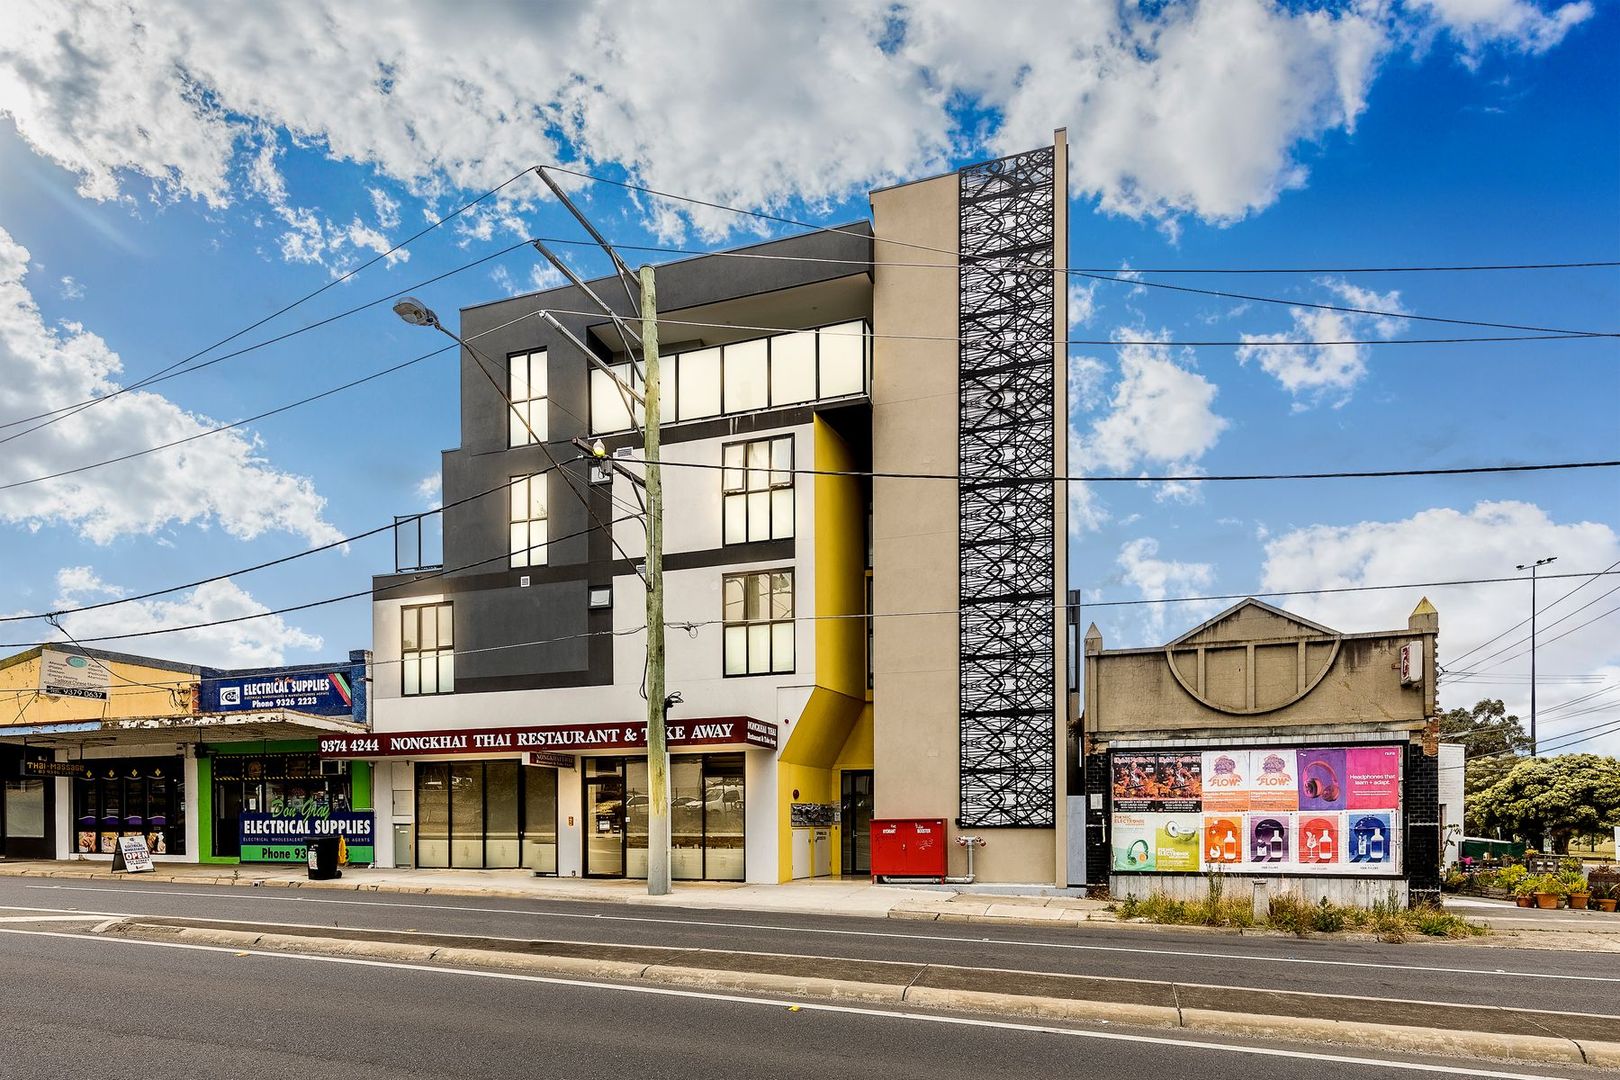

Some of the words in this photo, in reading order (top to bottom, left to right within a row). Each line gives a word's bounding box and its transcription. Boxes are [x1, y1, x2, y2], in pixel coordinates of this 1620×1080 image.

[244, 681, 289, 696] ELECTRICAL
[292, 678, 330, 692] SUPPLIES
[252, 700, 274, 708] Phone
[298, 697, 317, 705] 2223
[390, 736, 467, 750] NONGKHAI
[473, 734, 512, 747] THAI
[517, 729, 620, 746] RESTAURANT
[624, 728, 637, 742] &
[641, 726, 685, 741] TKE
[691, 724, 734, 739] AWAY
[321, 740, 347, 752] 9374
[350, 739, 379, 752] 4244
[271, 799, 296, 818] Don
[301, 797, 331, 822] Gray
[244, 820, 310, 834] ELECTRICAL
[315, 820, 370, 834] SUPPLIES
[126, 852, 148, 860] OPEN
[262, 848, 290, 859] Phone
